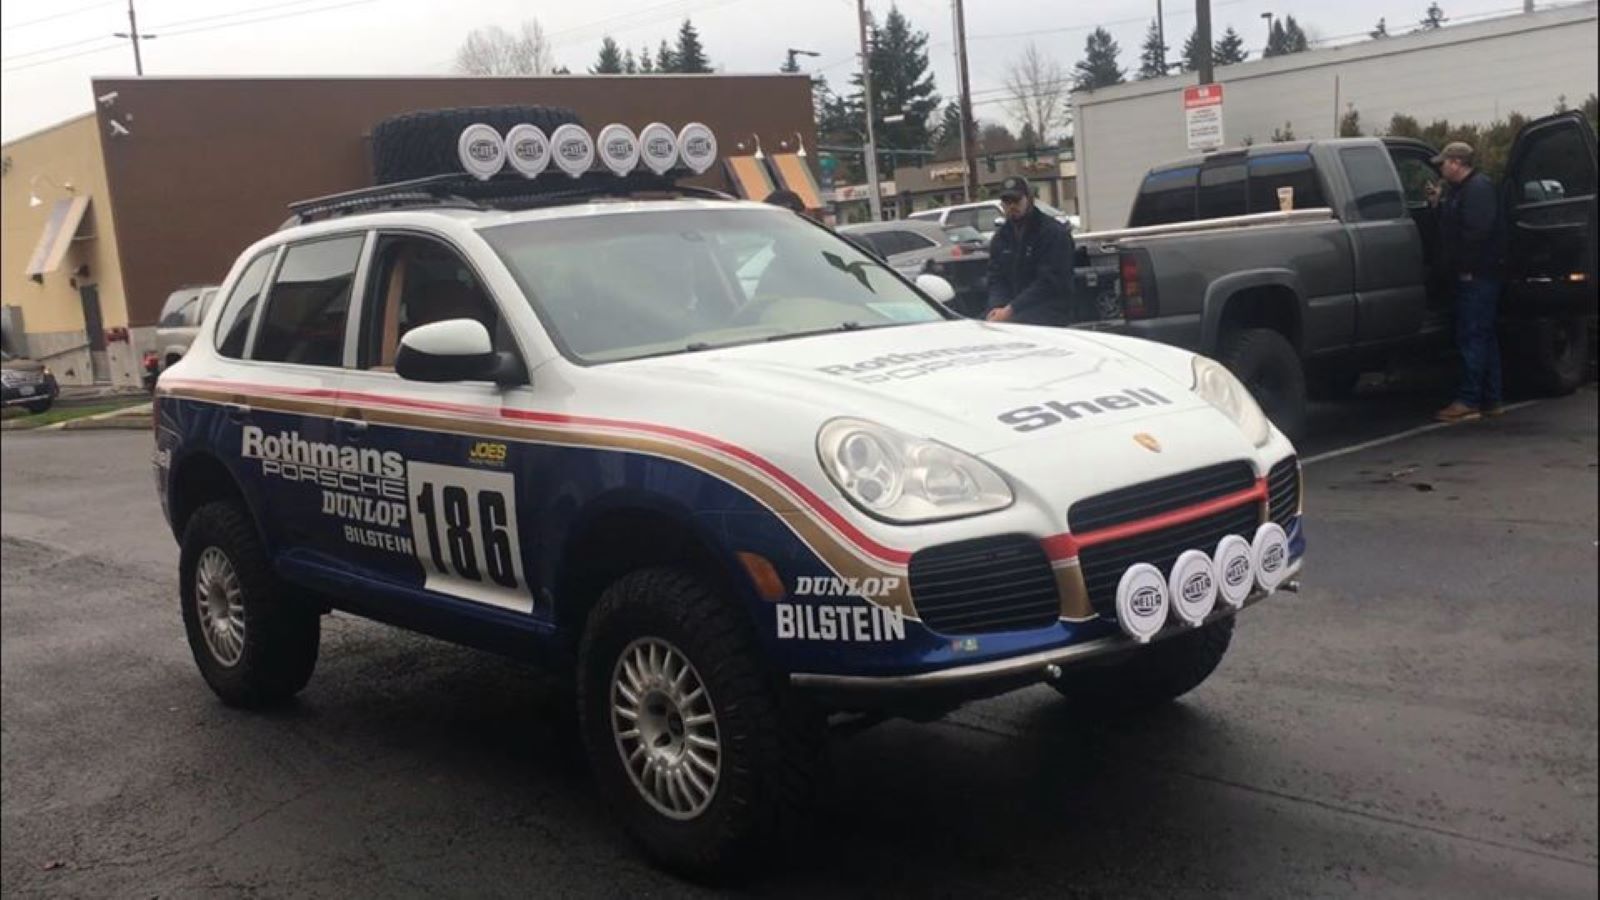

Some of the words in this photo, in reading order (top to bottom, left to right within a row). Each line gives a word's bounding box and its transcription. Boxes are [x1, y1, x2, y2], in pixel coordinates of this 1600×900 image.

[997, 387, 1174, 432] Shell
[242, 425, 405, 478] Rothmans
[470, 442, 507, 459] JOES
[262, 460, 406, 499] PORSCHE
[322, 490, 407, 528] DUNLOP
[344, 525, 414, 555] BILSTEIN
[416, 480, 518, 589] 186
[794, 576, 900, 597] DUNLOP
[776, 603, 906, 642] BILSTEIN
